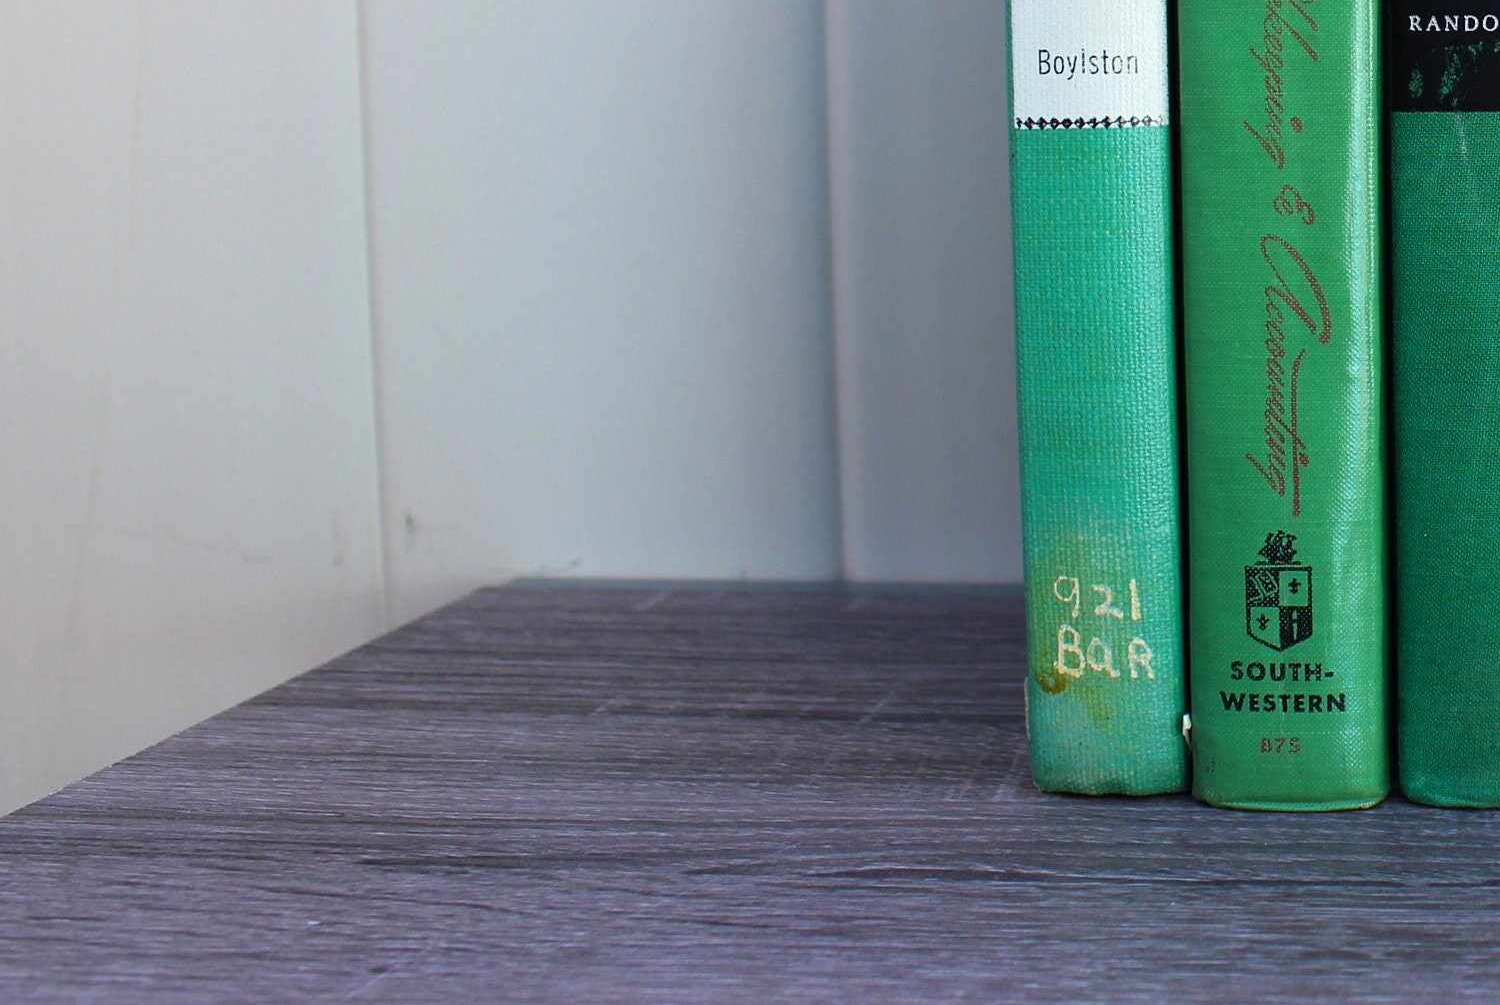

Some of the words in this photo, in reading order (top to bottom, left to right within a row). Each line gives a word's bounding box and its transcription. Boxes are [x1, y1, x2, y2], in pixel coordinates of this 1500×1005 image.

[1038, 48, 1139, 80] Boylston
[1245, 233, 1332, 517] Accounting
[1054, 576, 1141, 621] 921
[1230, 660, 1335, 682] SOUTH-
[1219, 691, 1347, 713] WESTERN
